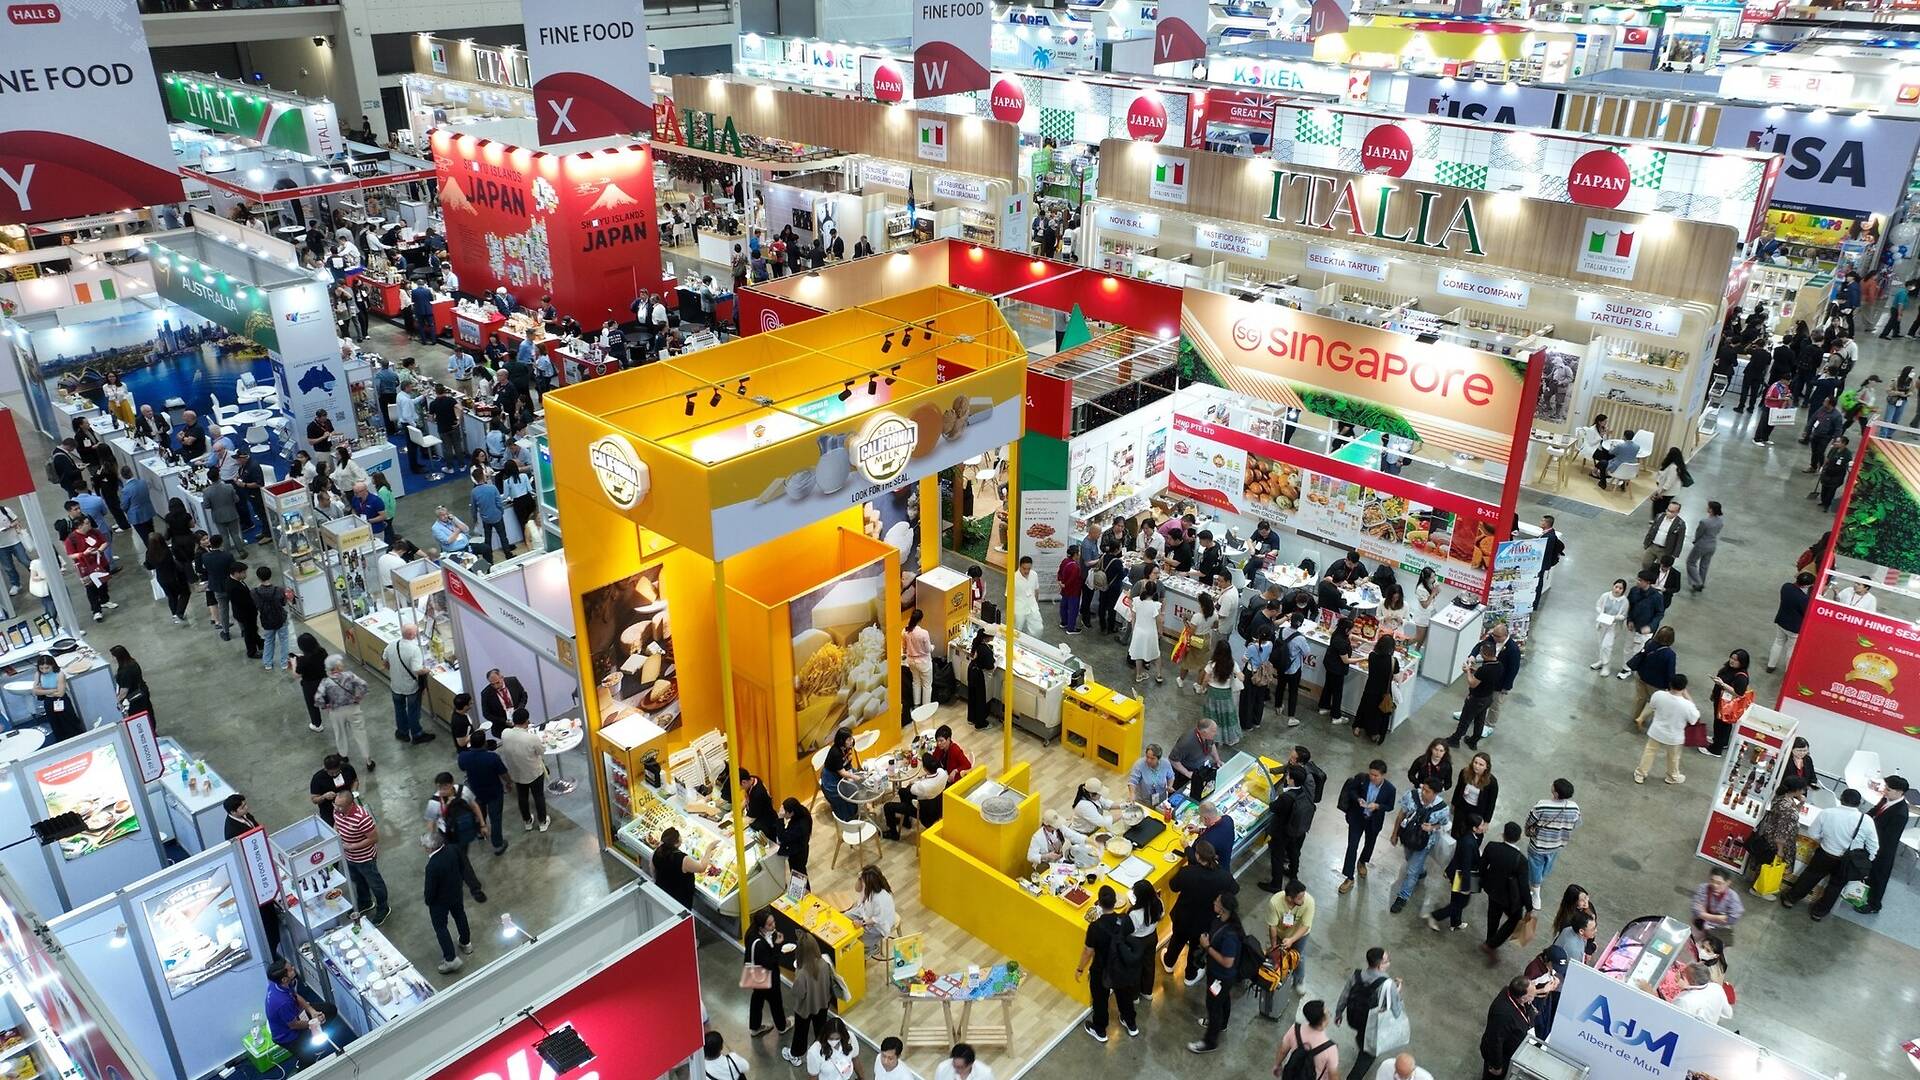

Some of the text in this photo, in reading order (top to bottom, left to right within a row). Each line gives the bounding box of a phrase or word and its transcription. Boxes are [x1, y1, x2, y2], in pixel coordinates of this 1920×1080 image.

[13, 8, 56, 20] HALL 8
[923, 2, 984, 20] FINE FOOD
[1314, 11, 1325, 32] U
[540, 21, 634, 45] FINE FOOD
[1161, 34, 1173, 58] V
[0, 63, 133, 93] NE FOOD
[472, 47, 533, 89] ITALI
[922, 60, 949, 91] W
[1234, 65, 1304, 90] KOREA
[876, 80, 902, 93] JAPAN
[184, 86, 241, 129] ITALIA
[993, 96, 1022, 110] JAPAN
[1230, 107, 1258, 119] GREAT
[548, 97, 577, 136] X
[1130, 113, 1165, 130] JAPAN
[313, 106, 332, 152] ITALIA
[1365, 144, 1409, 162] JAPAN
[1746, 130, 1867, 188] USA
[0, 163, 36, 212] Y
[1573, 172, 1626, 192] JAPAN
[466, 175, 526, 218] JAPAN
[612, 209, 645, 223] ISLANDS
[1109, 217, 1125, 226] NOVI
[1263, 169, 1488, 257] ITALIA
[582, 221, 647, 253] JAPAN
[1309, 253, 1380, 274] SELEKTIA TARTUFI
[182, 276, 240, 315] AUSTRALIA
[1443, 279, 1523, 301] COMEX COMPANY
[1605, 302, 1653, 319] SULPIZIO
[1237, 325, 1258, 343] SG
[1590, 311, 1664, 334] TARTUFI S.R.L.
[1203, 426, 1215, 436] LTD
[860, 428, 915, 461] CALIFORNIA
[874, 448, 900, 465] MILK
[852, 490, 868, 503] LOOK
[868, 484, 881, 497] FOR
[1816, 606, 1834, 618] OH
[1835, 611, 1863, 626] CHIN
[1865, 619, 1893, 634] HING
[1578, 1030, 1661, 1077] Albert de Mun
